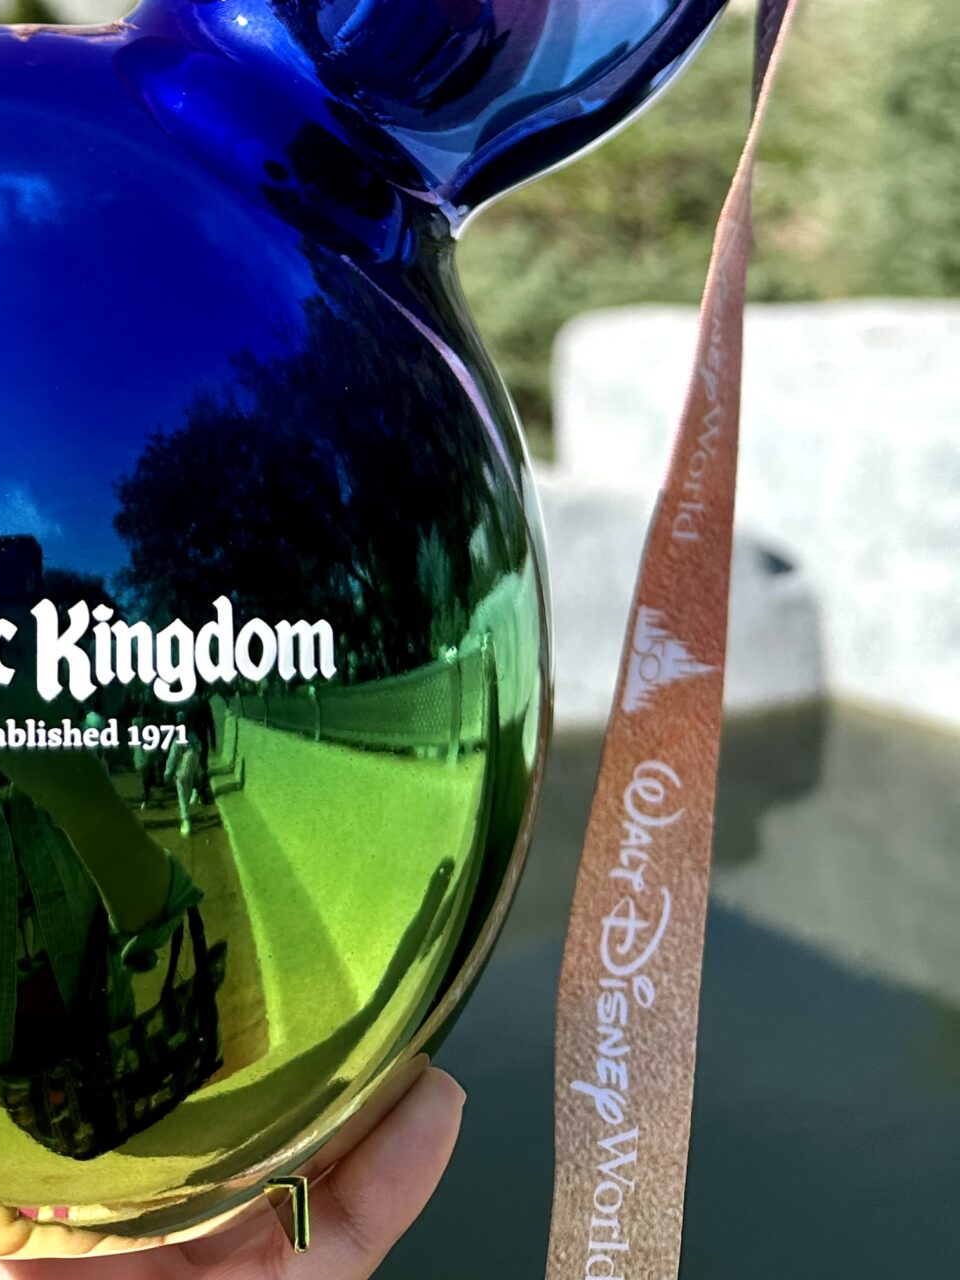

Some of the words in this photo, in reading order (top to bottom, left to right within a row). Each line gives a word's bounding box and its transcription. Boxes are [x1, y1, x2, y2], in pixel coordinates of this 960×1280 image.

[671, 410, 722, 541] World
[30, 595, 337, 702] Kingdom
[128, 724, 188, 751] 1971
[584, 1124, 640, 1280] World
